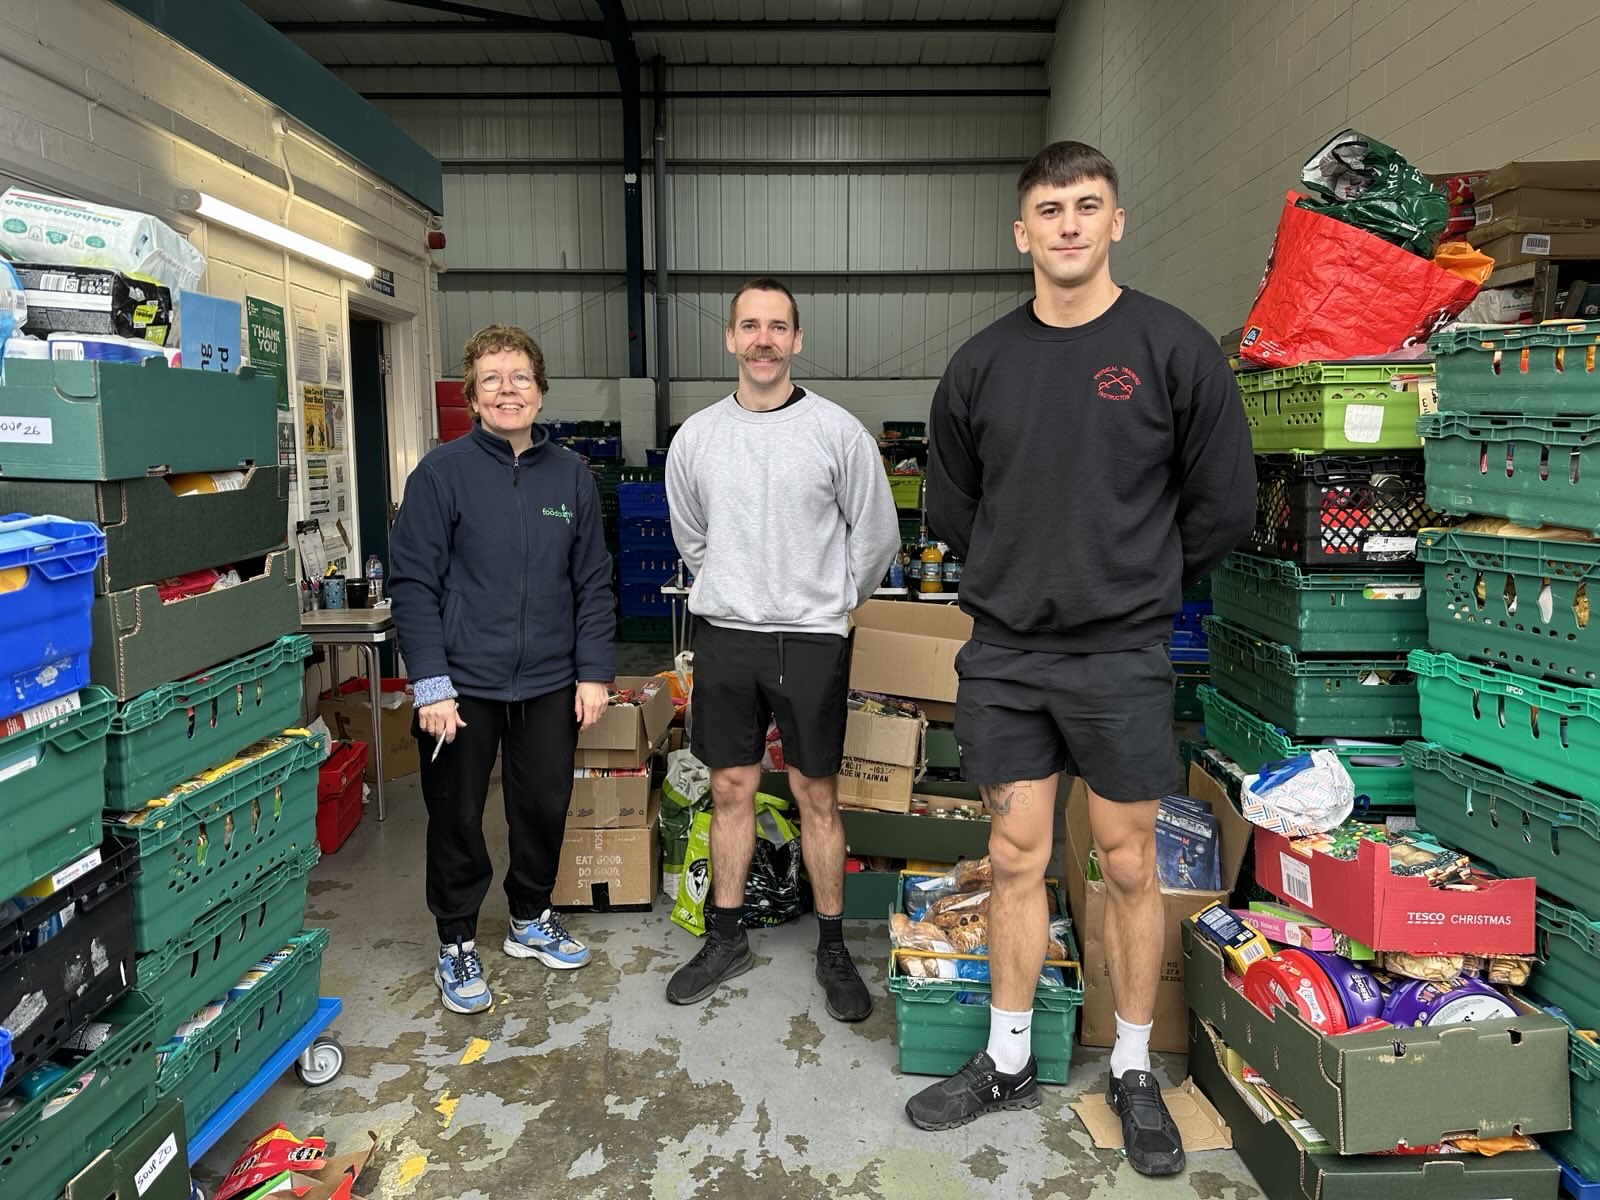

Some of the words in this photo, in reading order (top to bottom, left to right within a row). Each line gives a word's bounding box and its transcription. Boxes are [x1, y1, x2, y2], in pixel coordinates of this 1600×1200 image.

[251, 323, 281, 342] THANK
[257, 337, 278, 354] YOU!
[0, 421, 22, 431] OUP
[1506, 684, 1524, 696] IFCO
[862, 772, 889, 782] TAIWAN
[575, 855, 593, 865] EAT
[578, 867, 592, 877] DO
[1407, 911, 1446, 922] TESCO
[1450, 914, 1512, 926] CHRISTMAS
[1351, 973, 1372, 1003] HEROES
[137, 1159, 157, 1190] SOUP
